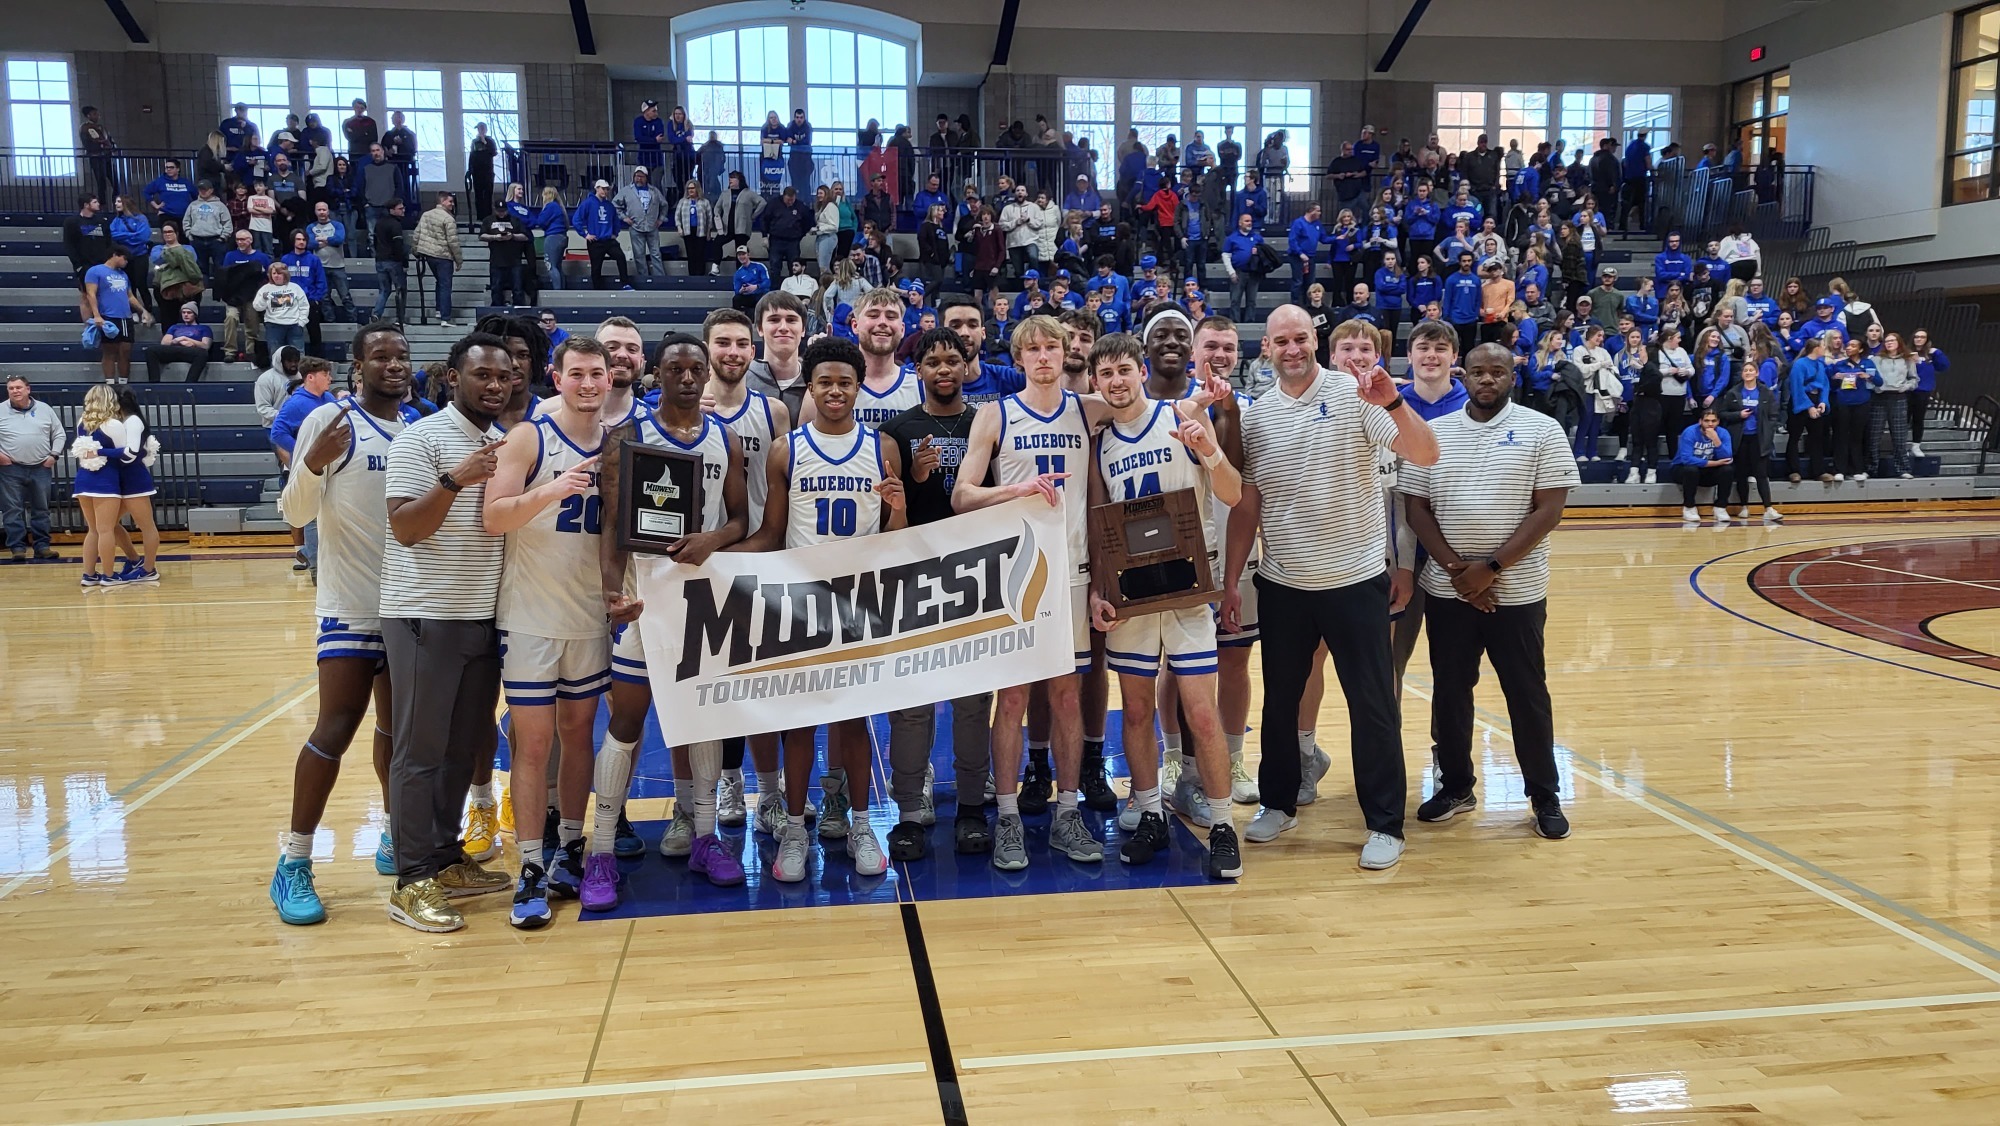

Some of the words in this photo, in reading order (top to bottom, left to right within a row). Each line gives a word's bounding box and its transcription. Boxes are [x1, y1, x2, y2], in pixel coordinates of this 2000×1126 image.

[764, 167, 785, 175] NCAA
[853, 408, 905, 422] LUEBO
[1014, 433, 1081, 450] BLUEBOYS
[1035, 455, 1065, 492] 11
[1109, 447, 1172, 478] BLUEBOYS
[645, 483, 676, 494] MIDWEST
[799, 475, 873, 493] BLUEBOYS
[1123, 472, 1162, 500] 14
[555, 493, 602, 535] 20
[815, 498, 857, 536] 10
[1123, 499, 1163, 515] MIDWEST
[676, 535, 1020, 682] MIDWEST
[1040, 610, 1052, 619] TM
[696, 660, 885, 706] TOURNAMENT
[894, 625, 1035, 678] CHAMPION
